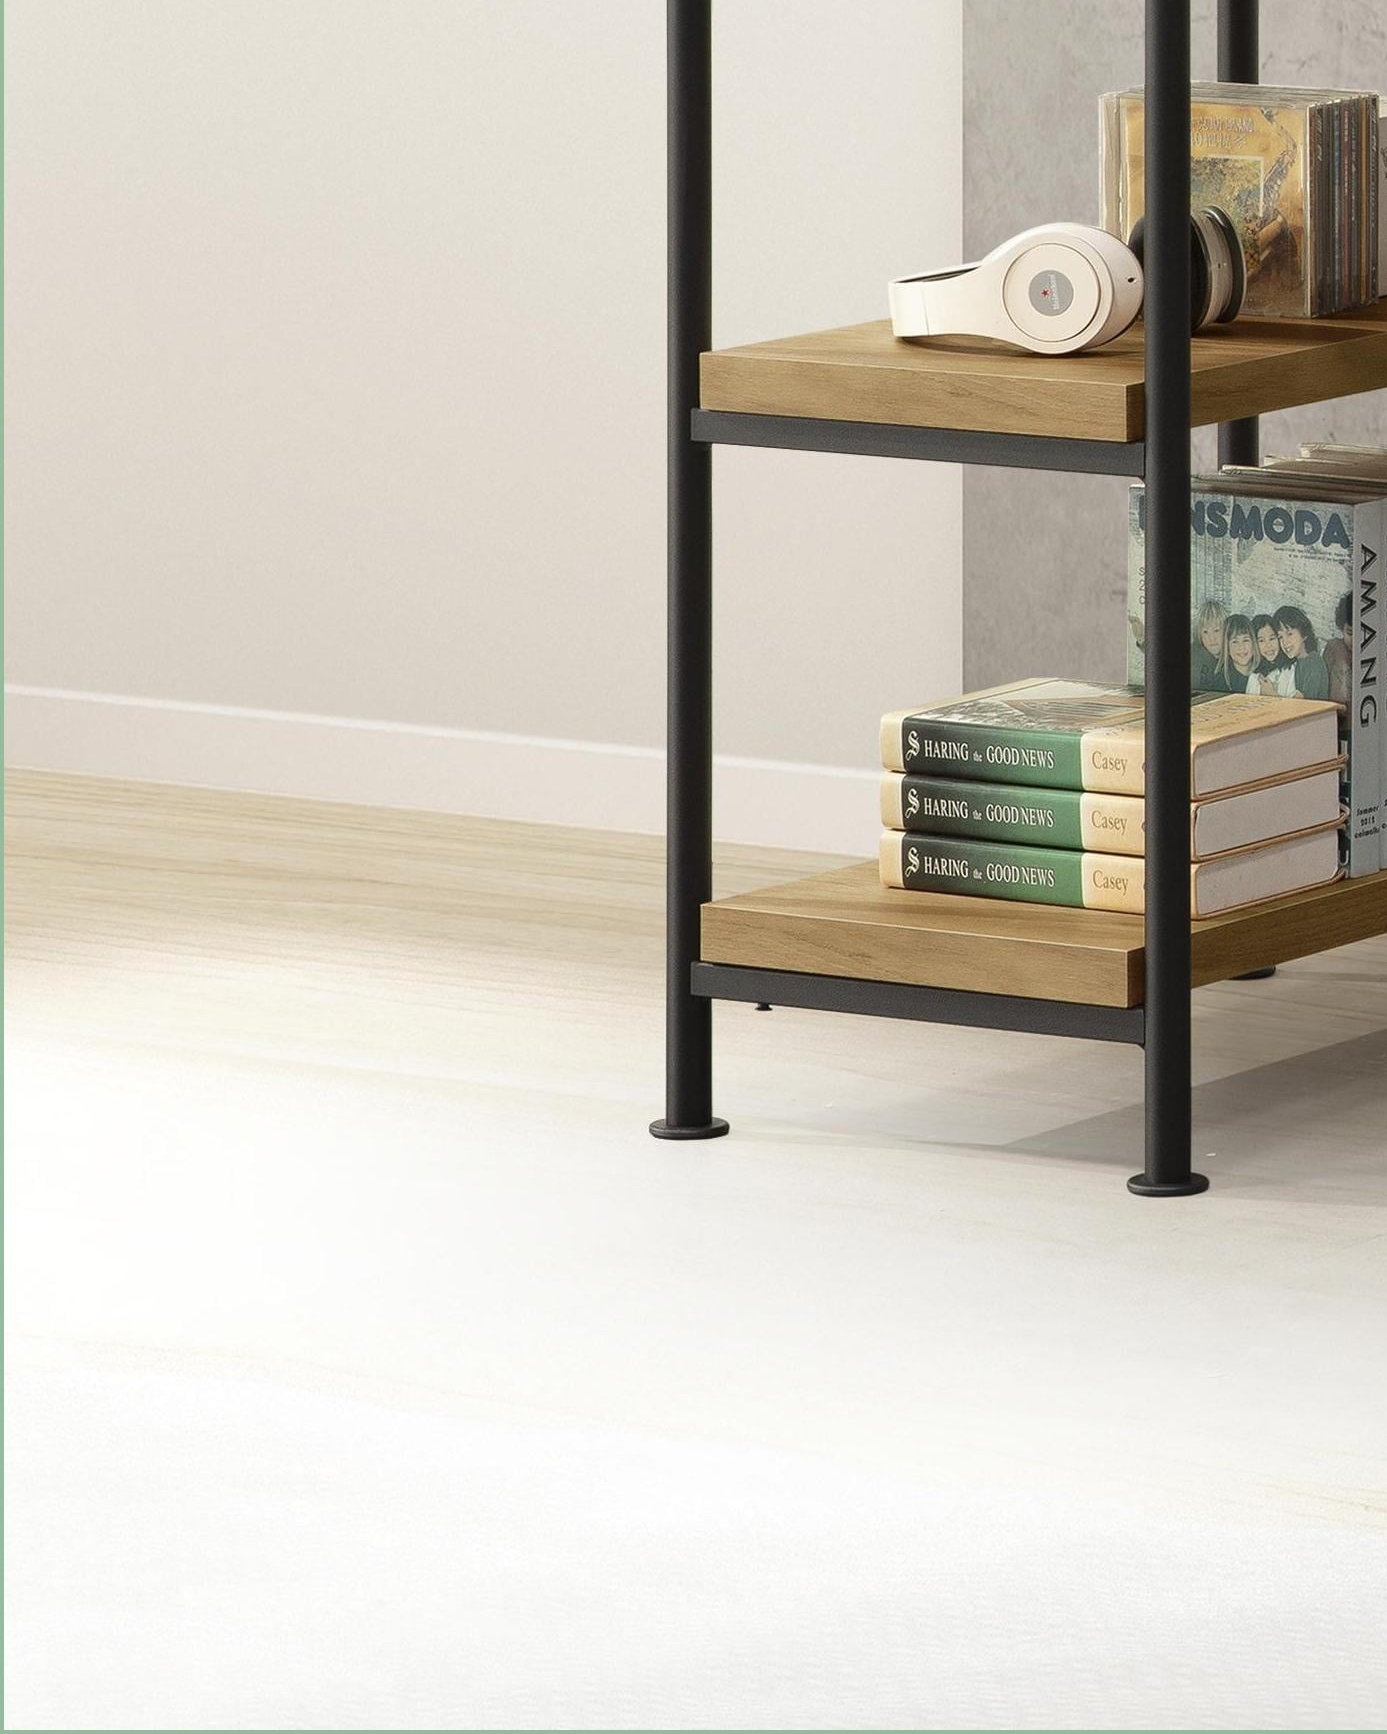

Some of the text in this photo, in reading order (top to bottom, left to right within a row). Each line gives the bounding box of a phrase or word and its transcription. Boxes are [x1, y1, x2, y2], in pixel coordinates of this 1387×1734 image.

[1359, 543, 1377, 728] AMANG
[973, 752, 982, 763] the
[987, 745, 1020, 766] GOOD
[1022, 749, 1054, 769] NEWS
[1091, 751, 1128, 777] Casey
[972, 810, 982, 820] the
[986, 804, 1019, 824] GOOD
[1021, 807, 1054, 827] NEWS
[1091, 811, 1127, 836] Casey
[973, 869, 982, 880] the
[986, 863, 1020, 883] GOOD
[1022, 867, 1055, 888] NEWS
[1092, 870, 1128, 895] Casey
